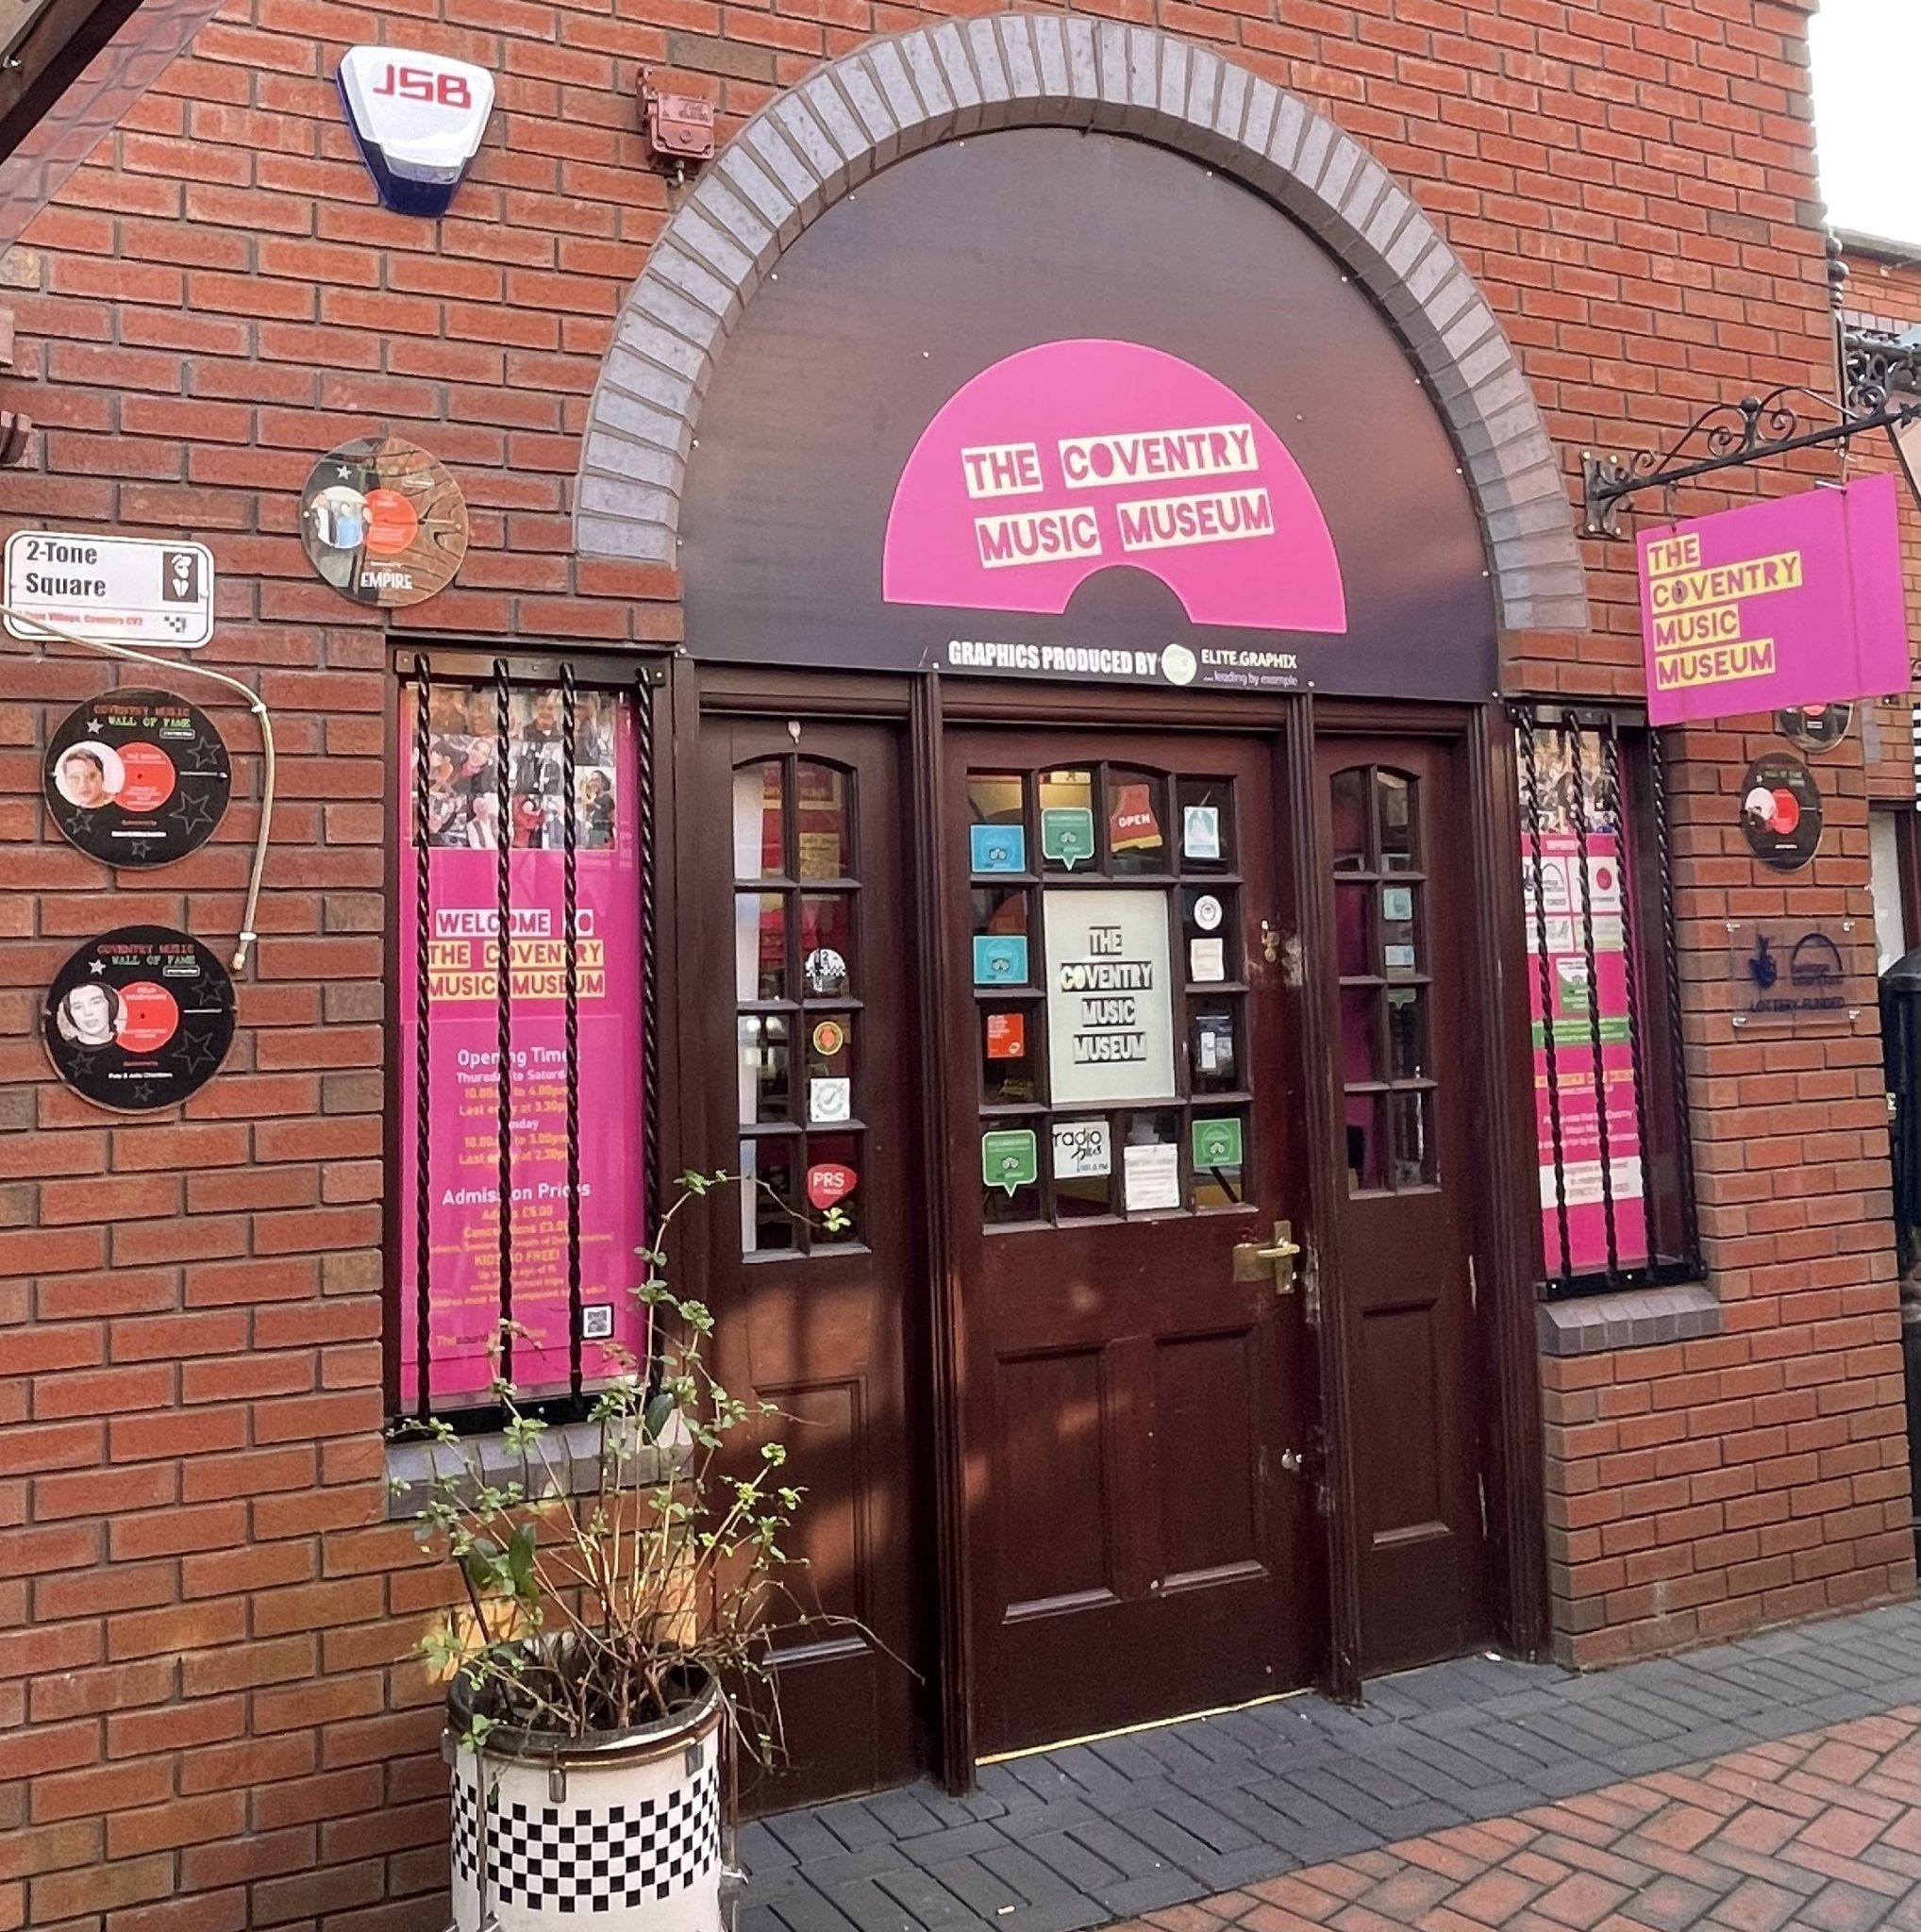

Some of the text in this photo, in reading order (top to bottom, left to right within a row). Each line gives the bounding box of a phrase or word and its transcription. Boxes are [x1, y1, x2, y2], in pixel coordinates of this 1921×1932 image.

[373, 63, 471, 109] JSB
[965, 429, 1250, 491] THE COVENTRY
[978, 494, 1271, 561] MUSIC MUSEUM
[26, 540, 98, 564] 2-Tone
[1649, 537, 1699, 571] THE
[25, 573, 107, 597] Square
[359, 571, 413, 590] EMPIRE
[1653, 556, 1798, 608] COVENTRY
[1655, 609, 1738, 648] MUSIC
[948, 641, 1159, 675] GRAPHICS PRODUCED BY
[1658, 642, 1774, 686] MUSEUM
[1118, 813, 1151, 828] OPEN
[427, 944, 469, 964] THE
[1088, 926, 1123, 956] THE
[429, 975, 496, 996] MUSIC
[1061, 962, 1153, 990] COVENTRY
[1081, 997, 1135, 1026] MUSIC
[458, 1048, 526, 1069] Openng
[1073, 1033, 1147, 1063] MUSEUM
[1051, 1127, 1102, 1148] radio
[813, 1172, 845, 1189] PRS
